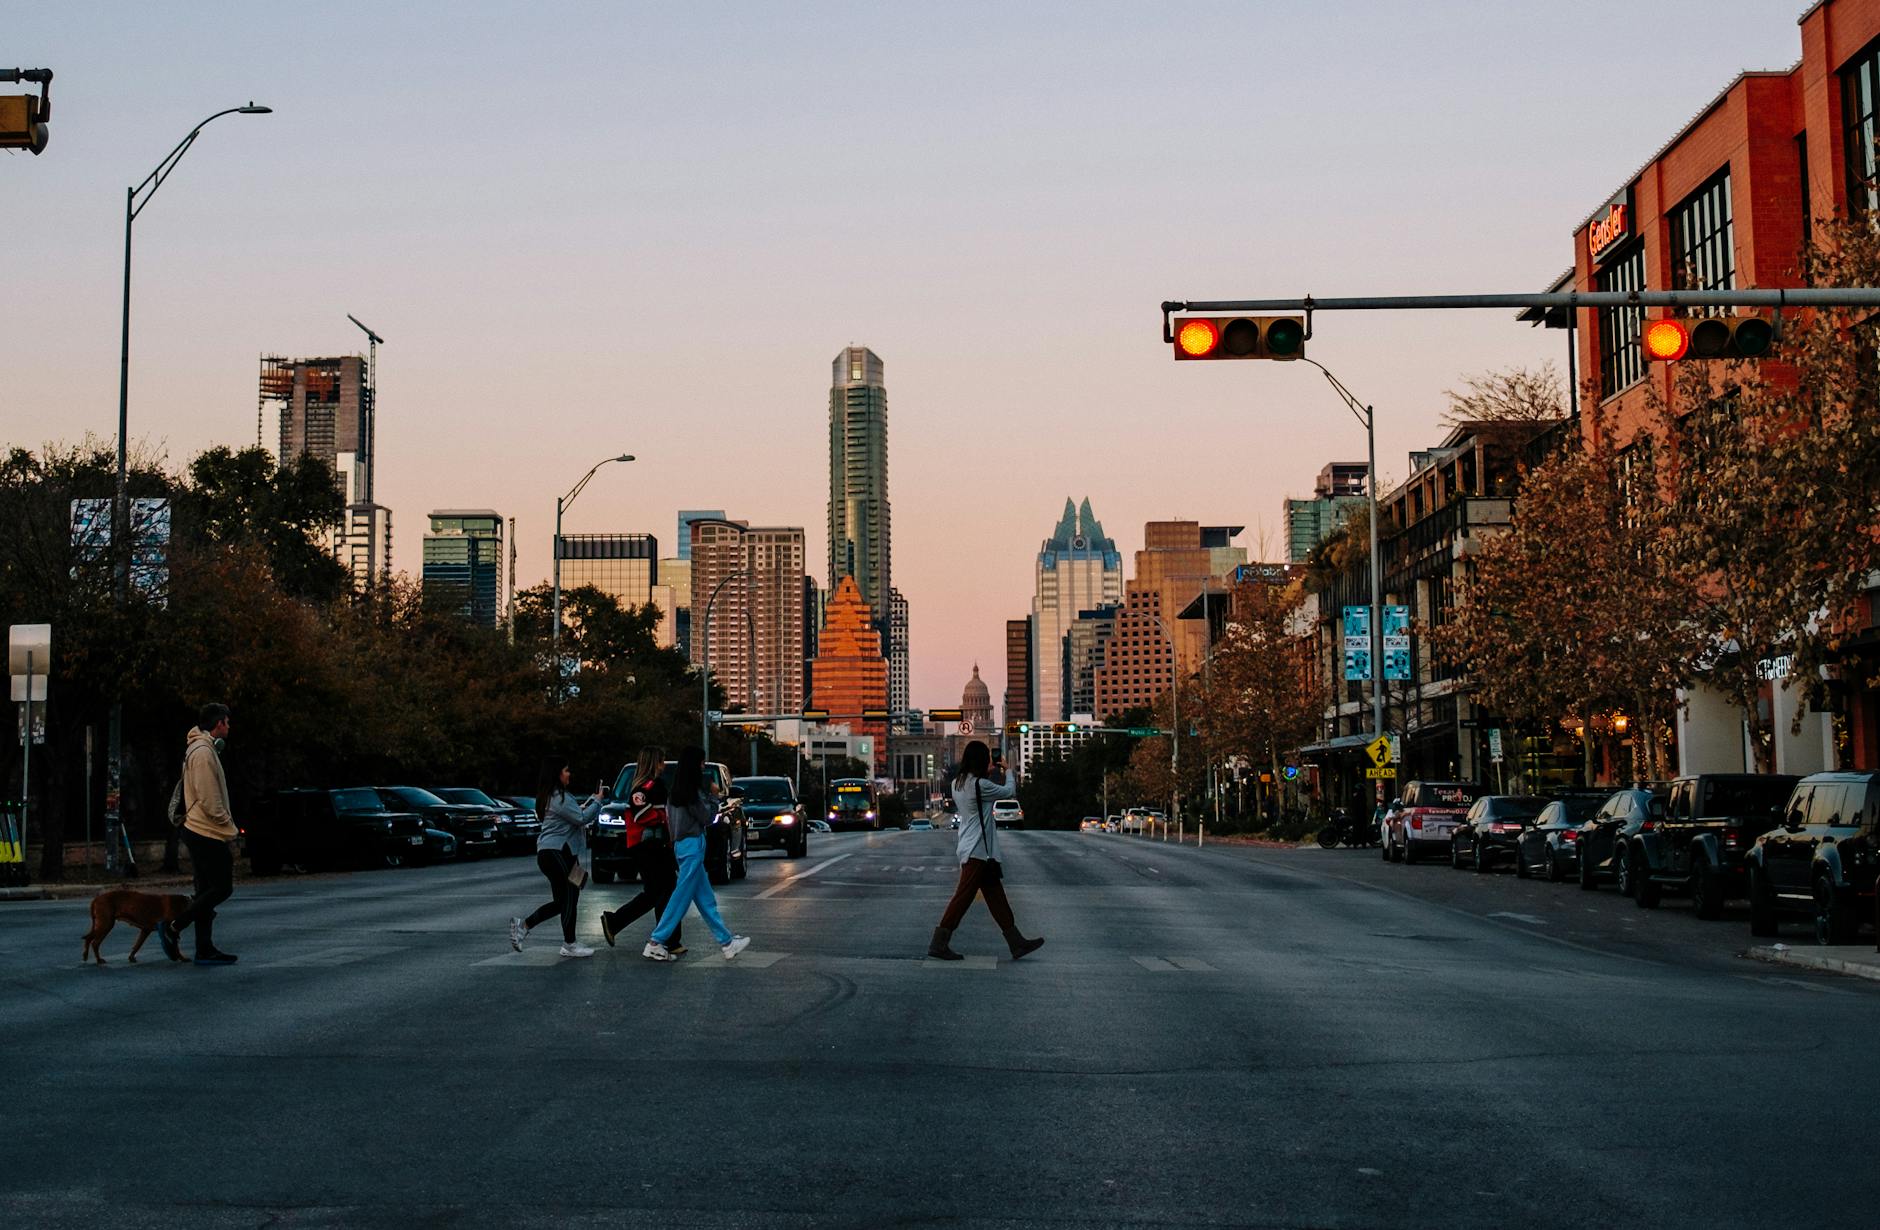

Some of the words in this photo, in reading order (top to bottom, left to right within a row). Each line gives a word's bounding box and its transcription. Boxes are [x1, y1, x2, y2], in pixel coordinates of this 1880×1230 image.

[1589, 204, 1625, 257] Gensler
[1369, 769, 1393, 777] AHEAD
[1463, 795, 1473, 803] DJ
